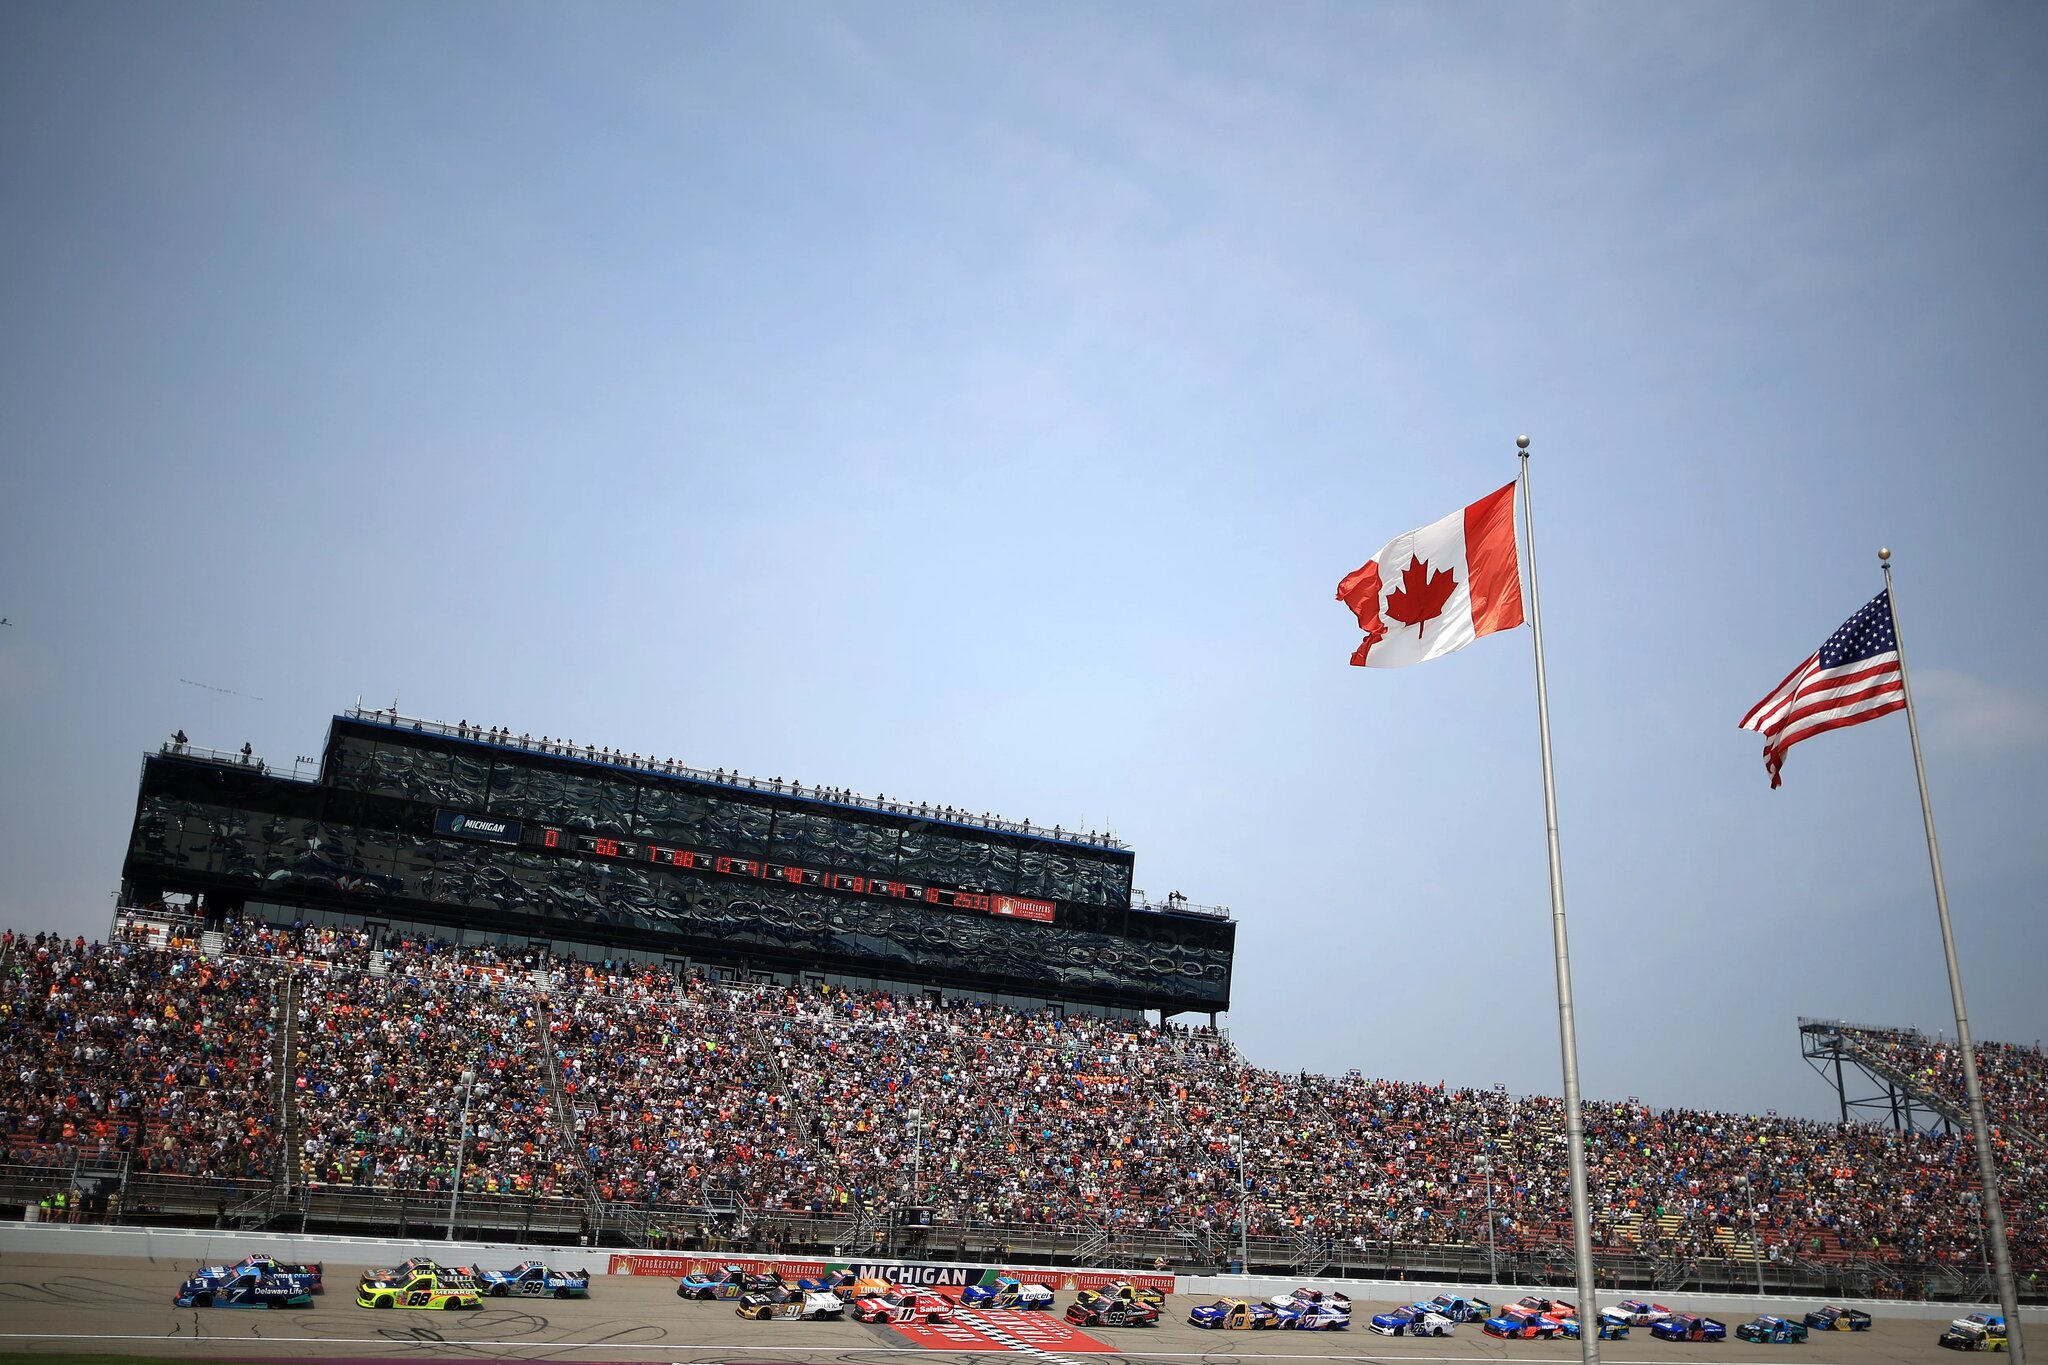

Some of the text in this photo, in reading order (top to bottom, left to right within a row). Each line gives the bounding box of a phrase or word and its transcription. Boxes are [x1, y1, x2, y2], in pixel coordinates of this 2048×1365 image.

[464, 819, 506, 833] MICHIGAN
[596, 838, 618, 857] 66
[666, 852, 674, 861] 3
[673, 850, 695, 869] 88
[703, 858, 711, 867] 4
[741, 863, 748, 872] 5
[914, 889, 924, 898] 10
[859, 1265, 967, 1286] MICHIGAN
[521, 1280, 545, 1294] 98
[548, 1279, 584, 1288] SODA SENSE
[230, 1288, 248, 1304] 7
[254, 1287, 303, 1296] Delaware Life
[725, 1286, 740, 1298] 81
[1024, 1292, 1050, 1300] telcel
[407, 1292, 432, 1306] 88
[1002, 1294, 1019, 1306] 77
[784, 1304, 801, 1318] 91
[899, 1308, 917, 1321] 11
[919, 1305, 950, 1313] Safelite
[1452, 1309, 1464, 1320] 34
[1107, 1311, 1126, 1325] 99
[1233, 1316, 1245, 1327] 19
[1304, 1315, 1319, 1328] 71
[1413, 1323, 1425, 1333] 26
